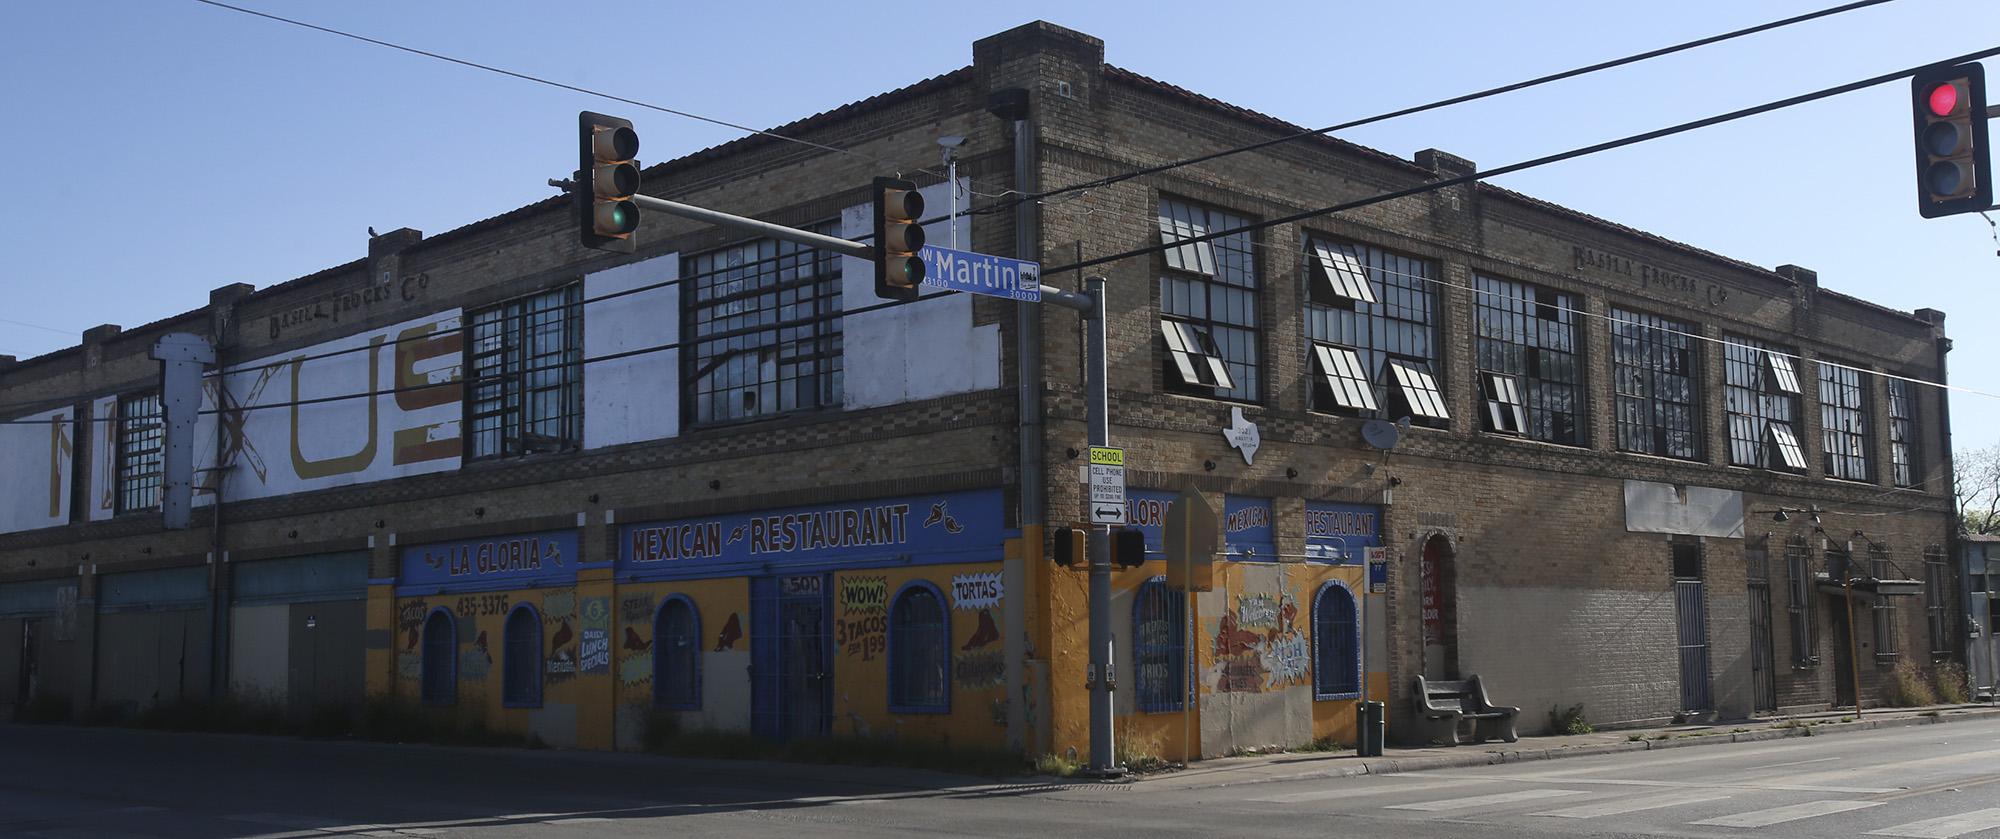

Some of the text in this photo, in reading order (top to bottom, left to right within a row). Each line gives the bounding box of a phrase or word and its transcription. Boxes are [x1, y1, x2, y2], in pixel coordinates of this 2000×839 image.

[923, 248, 1016, 290] W Martin
[1092, 451, 1122, 462] SCHOOL
[1092, 467, 1122, 477] CELL PHONE
[1102, 477, 1112, 485] USE
[1093, 485, 1122, 494] PROHIBITED
[1227, 506, 1270, 532] MEXICAN
[1306, 509, 1375, 537] RESTAURANT
[632, 504, 910, 562] MEXICAN RESTAURANT
[449, 538, 542, 576] LA GLORIA
[790, 577, 821, 593] 500
[845, 585, 884, 604] WOW!
[956, 582, 998, 600] TORTAS
[456, 594, 509, 617] 435-3376
[584, 631, 605, 640] DAILY
[837, 616, 888, 645] 3 TACOS
[582, 638, 608, 658] LUNCH
[581, 652, 609, 671] SPECIALS
